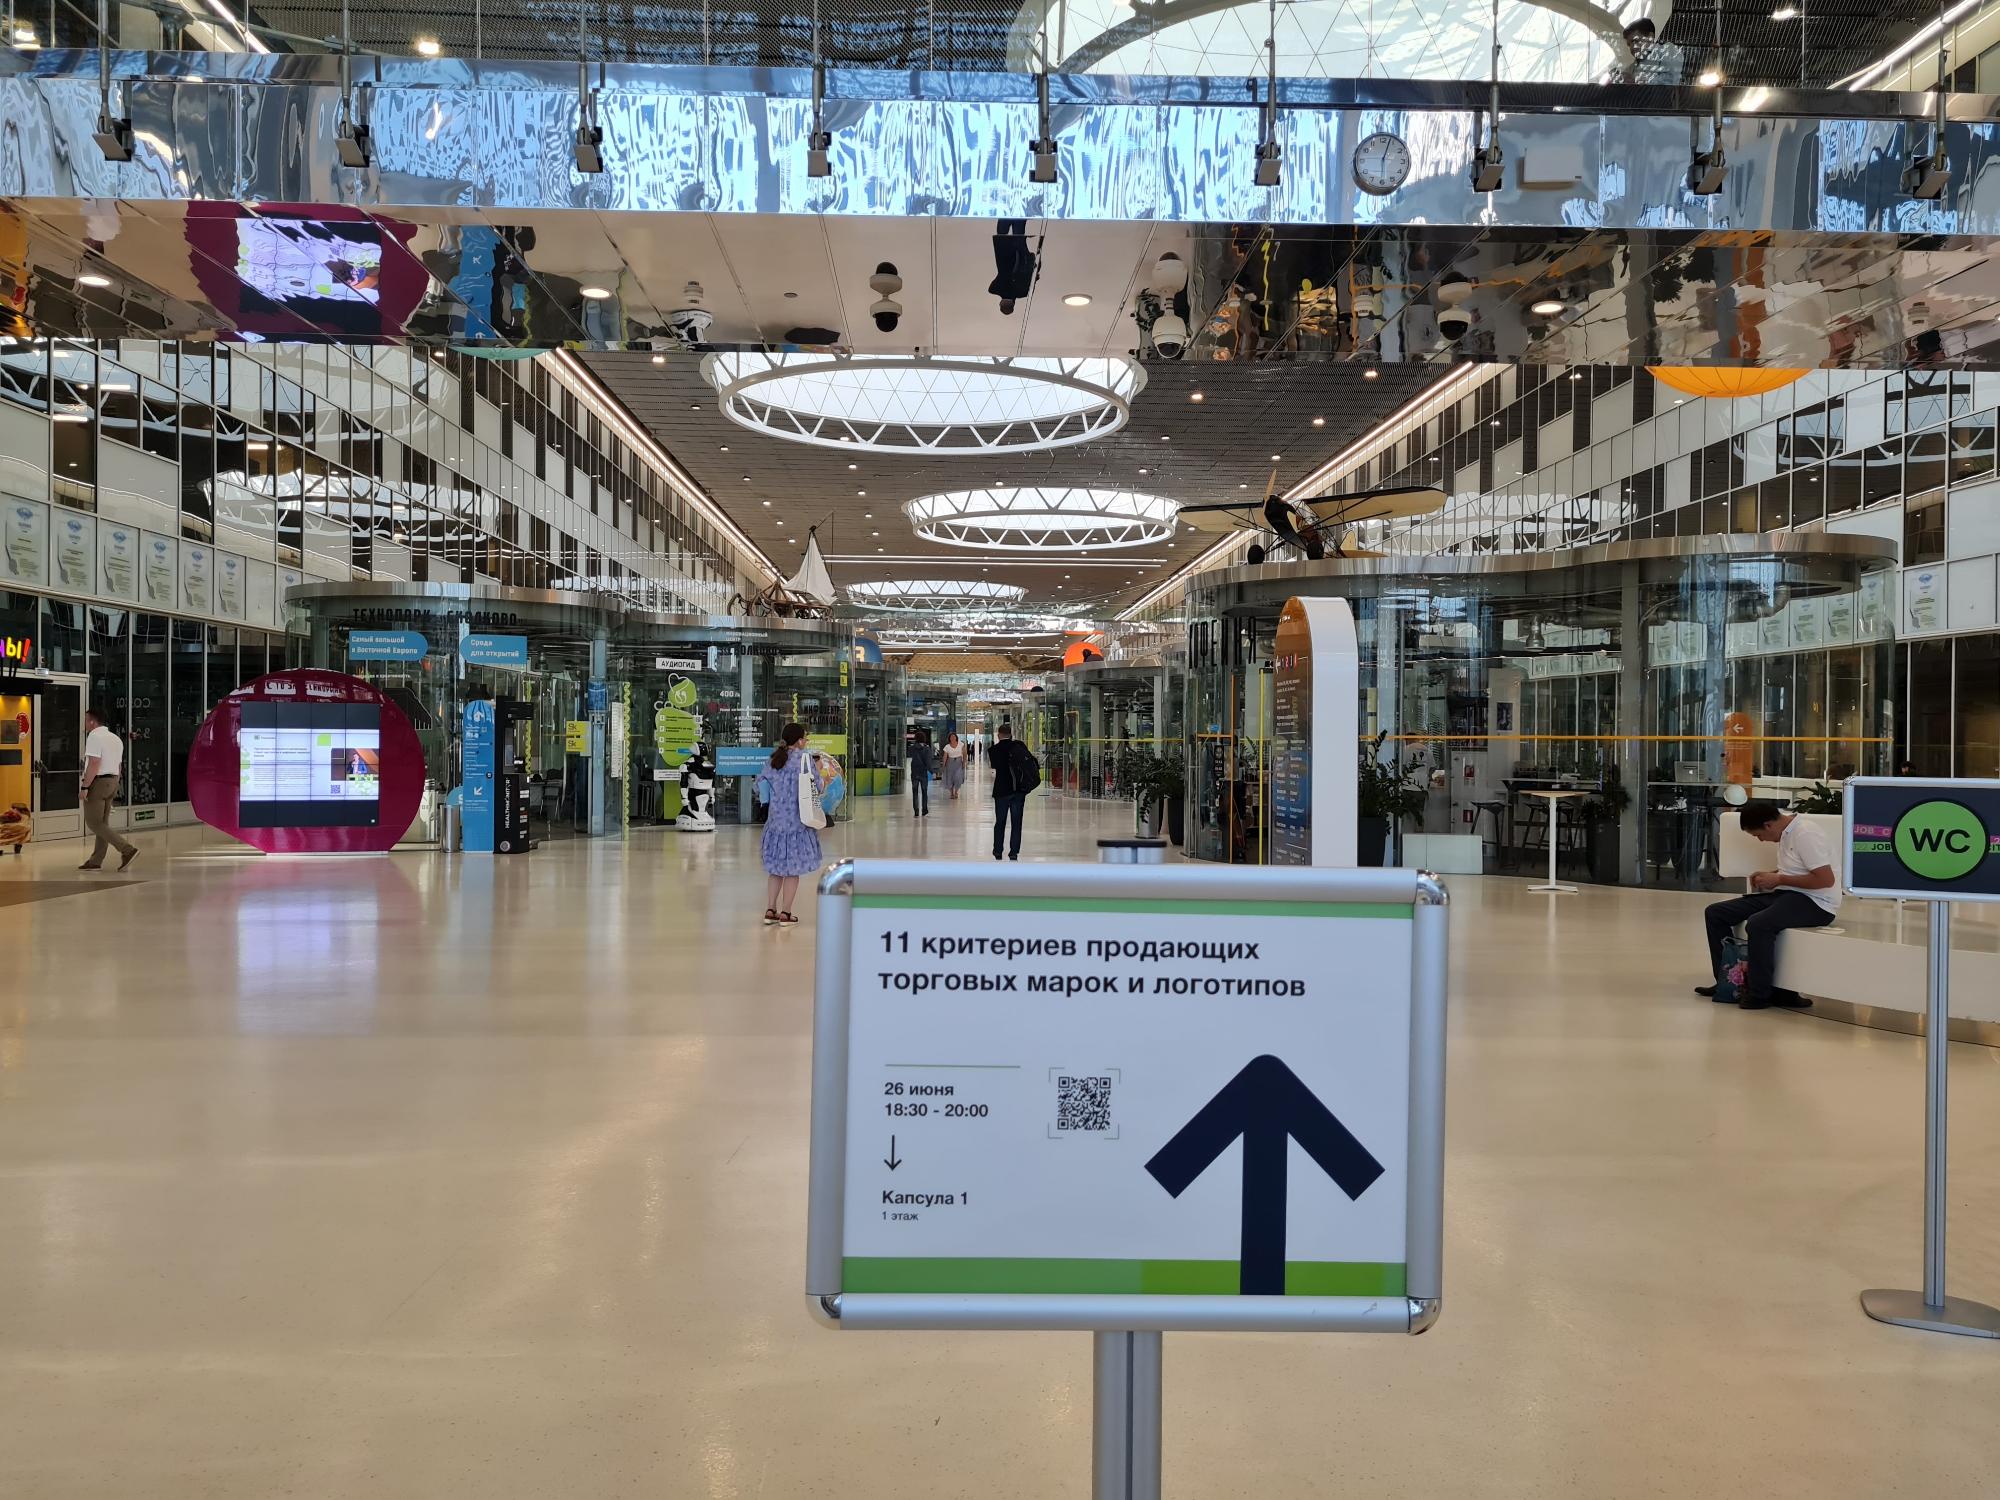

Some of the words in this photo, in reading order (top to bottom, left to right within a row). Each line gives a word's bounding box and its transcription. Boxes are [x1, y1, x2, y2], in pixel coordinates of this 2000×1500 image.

[661, 660, 696, 669] АУДИОГИД
[1854, 825, 1874, 834] JOB
[1871, 843, 1891, 851] JOB
[1909, 827, 1971, 853] WC
[881, 931, 909, 953] 11
[922, 937, 1077, 961] критериев
[1087, 940, 1260, 964] продающих
[877, 972, 1018, 996] торговых
[1027, 975, 1119, 998] марок
[1129, 977, 1144, 994] и
[1152, 978, 1306, 997] логотипов
[885, 1082, 905, 1096] 26
[909, 1085, 954, 1096] июня
[885, 1103, 928, 1117] 18:30
[944, 1103, 989, 1118] 20:00
[882, 1189, 955, 1207] Капсула
[960, 1191, 968, 1206] 1
[882, 1211, 887, 1221] 1
[891, 1212, 919, 1222] этаж
